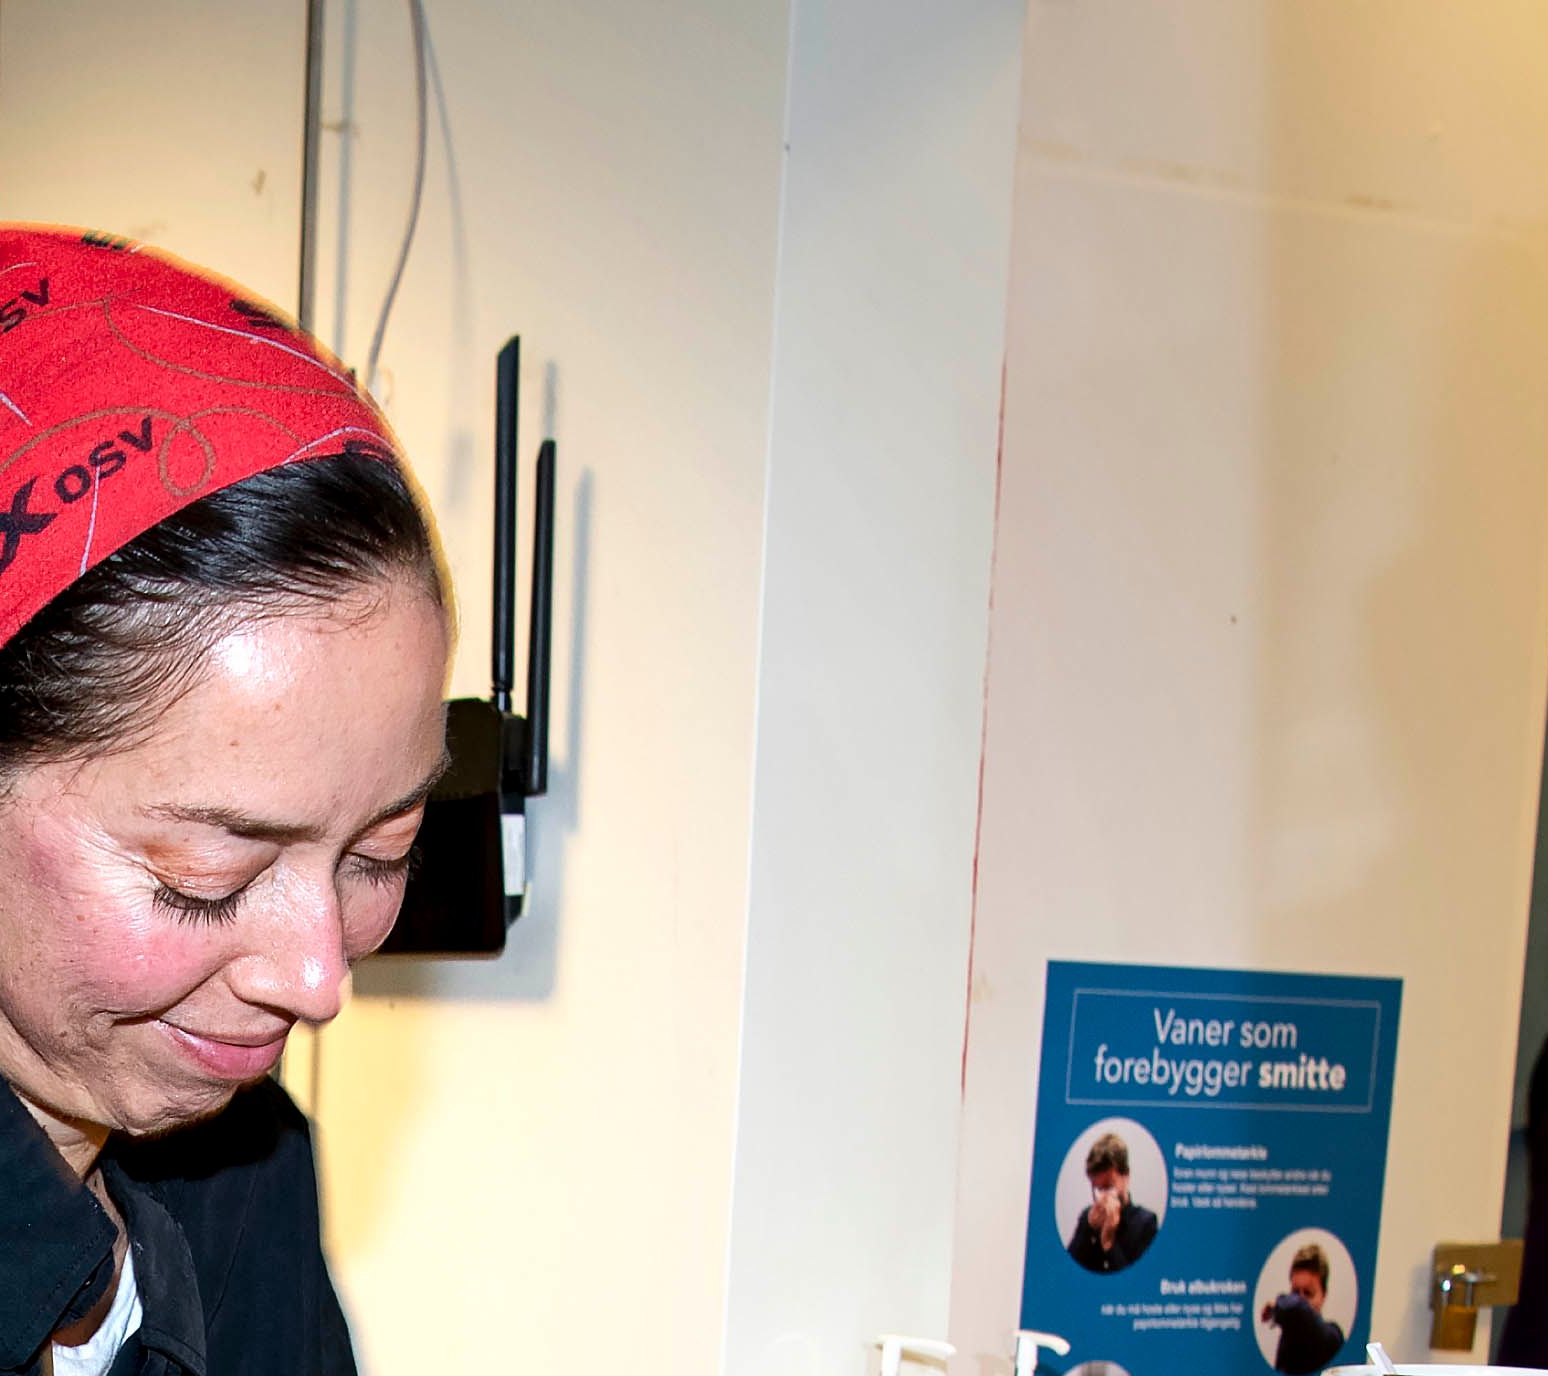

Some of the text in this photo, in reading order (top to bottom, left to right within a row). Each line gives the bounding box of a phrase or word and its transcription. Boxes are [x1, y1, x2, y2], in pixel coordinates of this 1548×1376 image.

[1153, 1007, 1298, 1049] Vaner som
[1094, 1043, 1347, 1097] forebygger smitte
